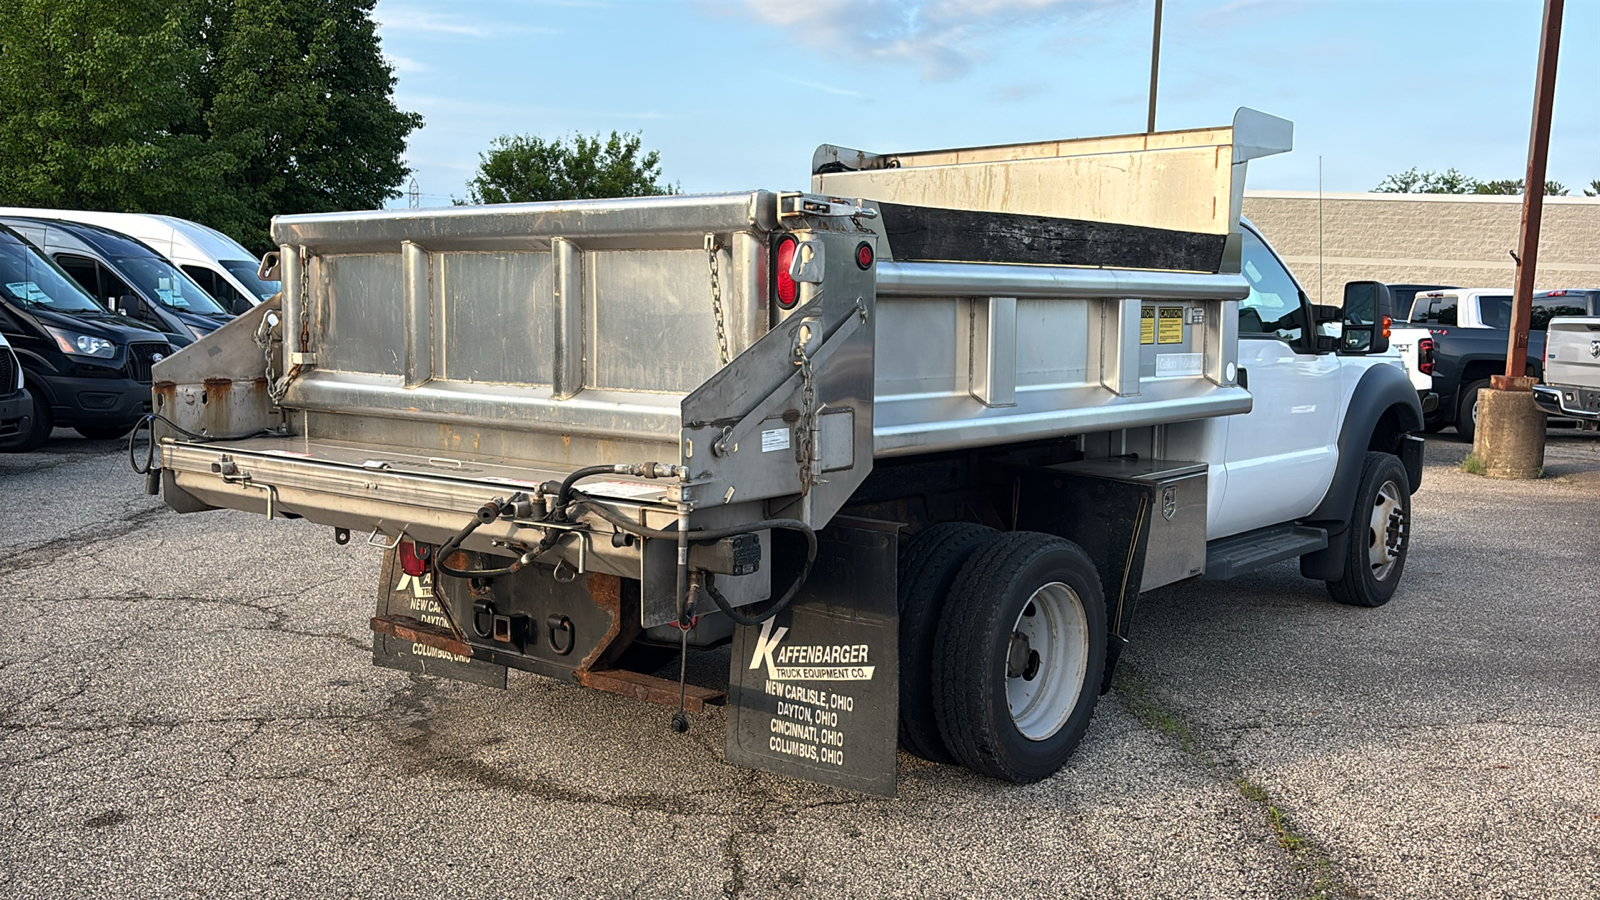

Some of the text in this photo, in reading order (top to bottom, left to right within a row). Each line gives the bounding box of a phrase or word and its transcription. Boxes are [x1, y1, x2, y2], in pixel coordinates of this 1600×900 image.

[1141, 309, 1154, 318] TION
[1159, 309, 1182, 318] CAUTION
[410, 597, 429, 612] NEW
[749, 614, 869, 669] KAFFENBARGER
[776, 667, 867, 679] TRUCK EQUIPMENT CO.
[765, 679, 854, 712] NEW CARLISLE, OHIO
[777, 701, 838, 728] DAYTON, OHIO
[770, 718, 844, 747] CINCINNATI, OHIO
[769, 736, 844, 766] COLUMBUS, OHIO
